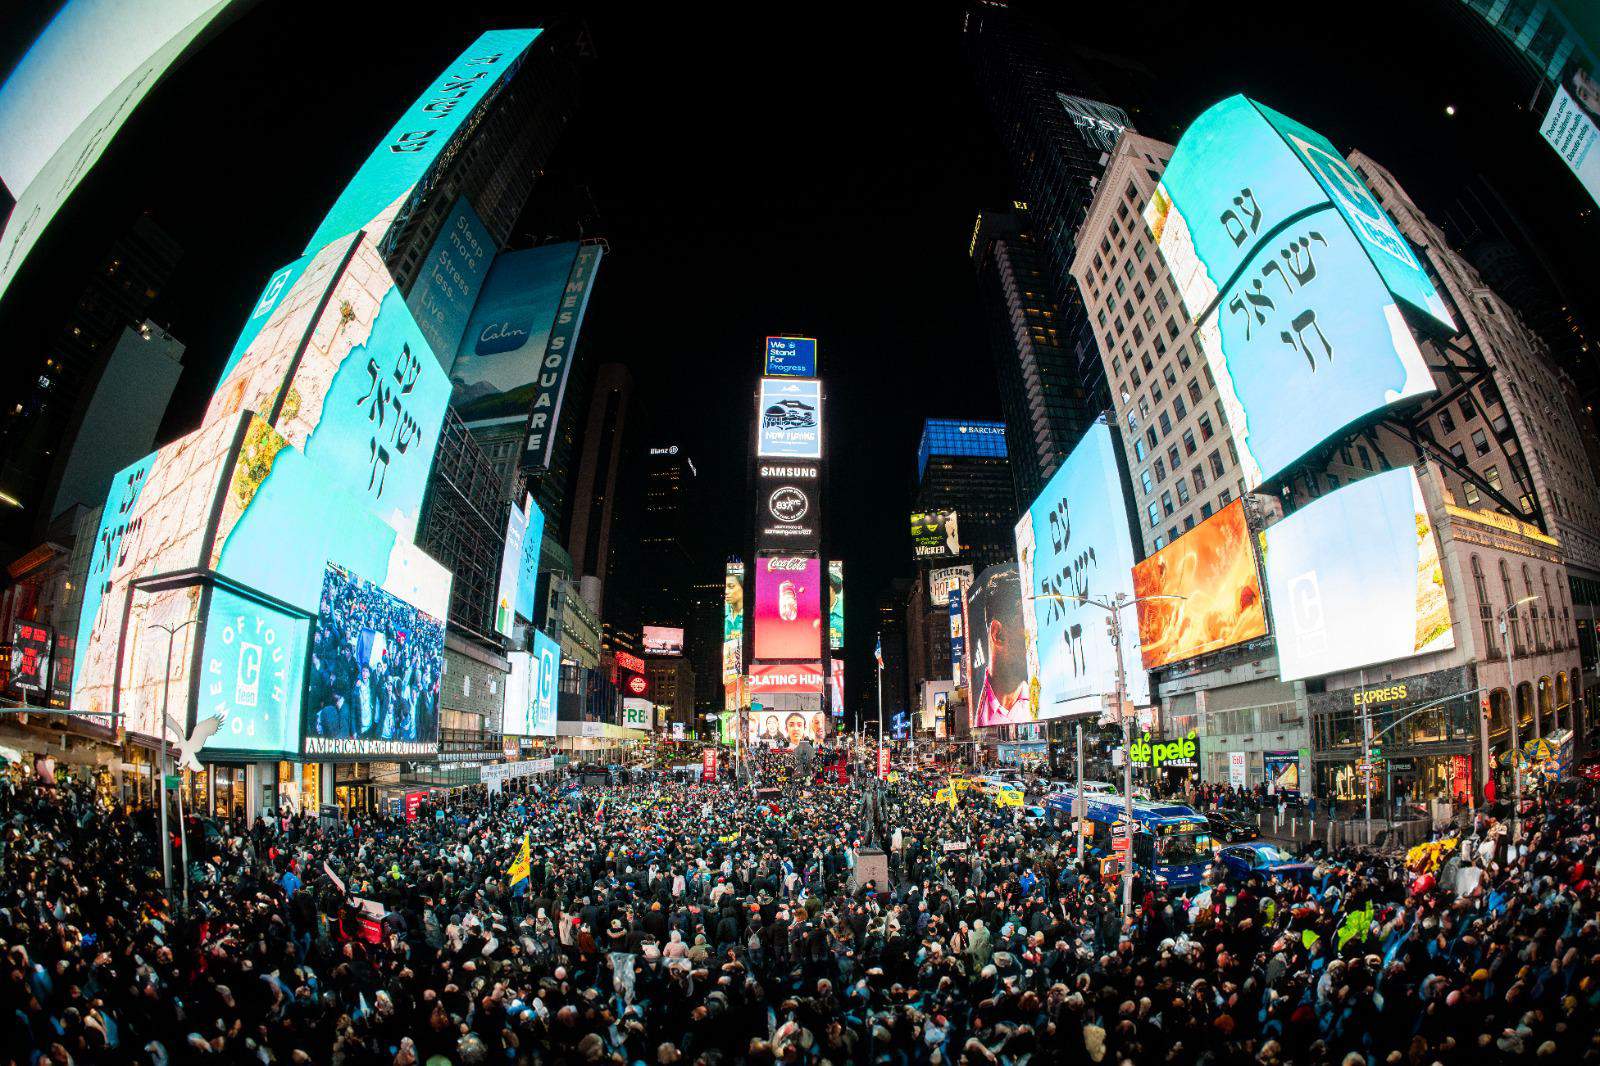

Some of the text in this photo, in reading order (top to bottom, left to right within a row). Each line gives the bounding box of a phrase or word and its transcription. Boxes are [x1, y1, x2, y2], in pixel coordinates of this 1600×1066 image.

[457, 216, 484, 258] Sleep
[1219, 187, 1263, 248] עם
[439, 250, 470, 297] Stress
[450, 231, 477, 274] more.
[1229, 231, 1328, 342] ישראל
[480, 321, 528, 343] Calm
[527, 254, 592, 451] TIMES SQUARE
[770, 341, 786, 349] We
[770, 348, 796, 356] Stand
[1280, 309, 1333, 373] חי
[393, 341, 422, 394] עם
[769, 355, 784, 363] For
[769, 364, 807, 372] Progress
[356, 357, 422, 456] ישראל
[968, 426, 1005, 434] BARCLAYS
[367, 436, 390, 500] חי
[761, 466, 817, 478] SAMSUNG
[1049, 498, 1071, 555] עם
[915, 545, 945, 555] WICKED
[934, 568, 954, 581] LITTLE
[1041, 546, 1097, 627] ישראל
[1064, 623, 1086, 678] חי
[1353, 685, 1408, 706] EXPRESS
[305, 737, 439, 754] AMERICAN EAGLE OUTFITTERS
